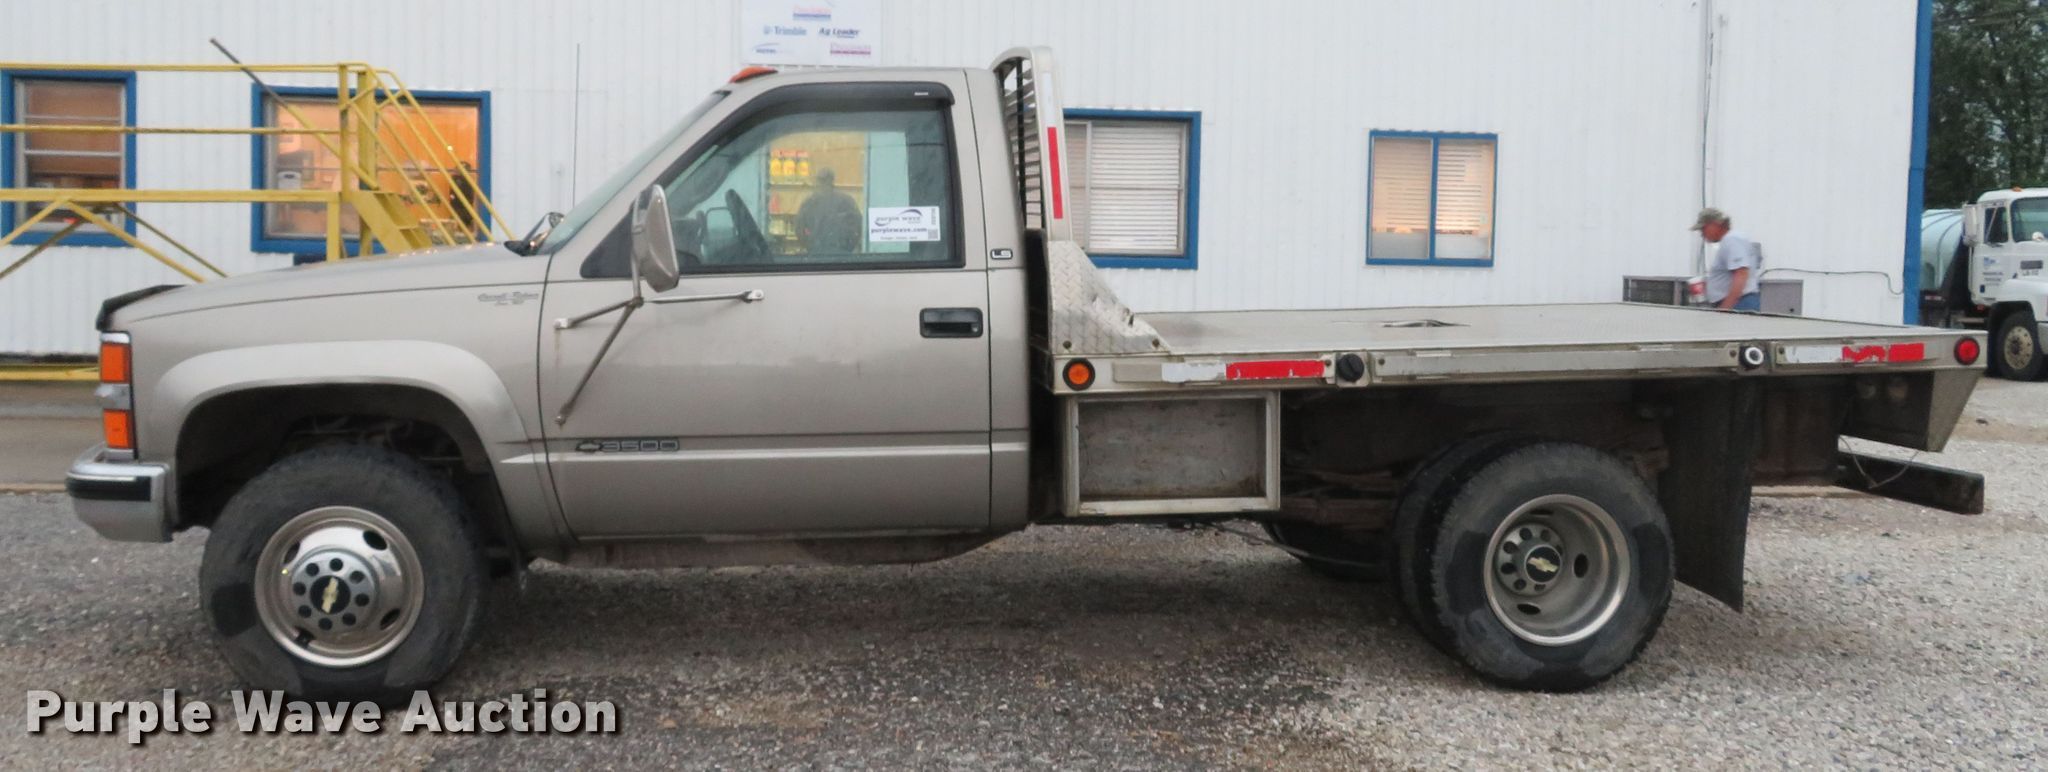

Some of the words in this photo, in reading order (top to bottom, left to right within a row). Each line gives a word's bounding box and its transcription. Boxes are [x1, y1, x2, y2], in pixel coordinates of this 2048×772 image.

[775, 25, 807, 36] Trimble
[819, 27, 831, 36] Ag
[832, 28, 860, 36] Leader
[601, 440, 679, 452] 3500
